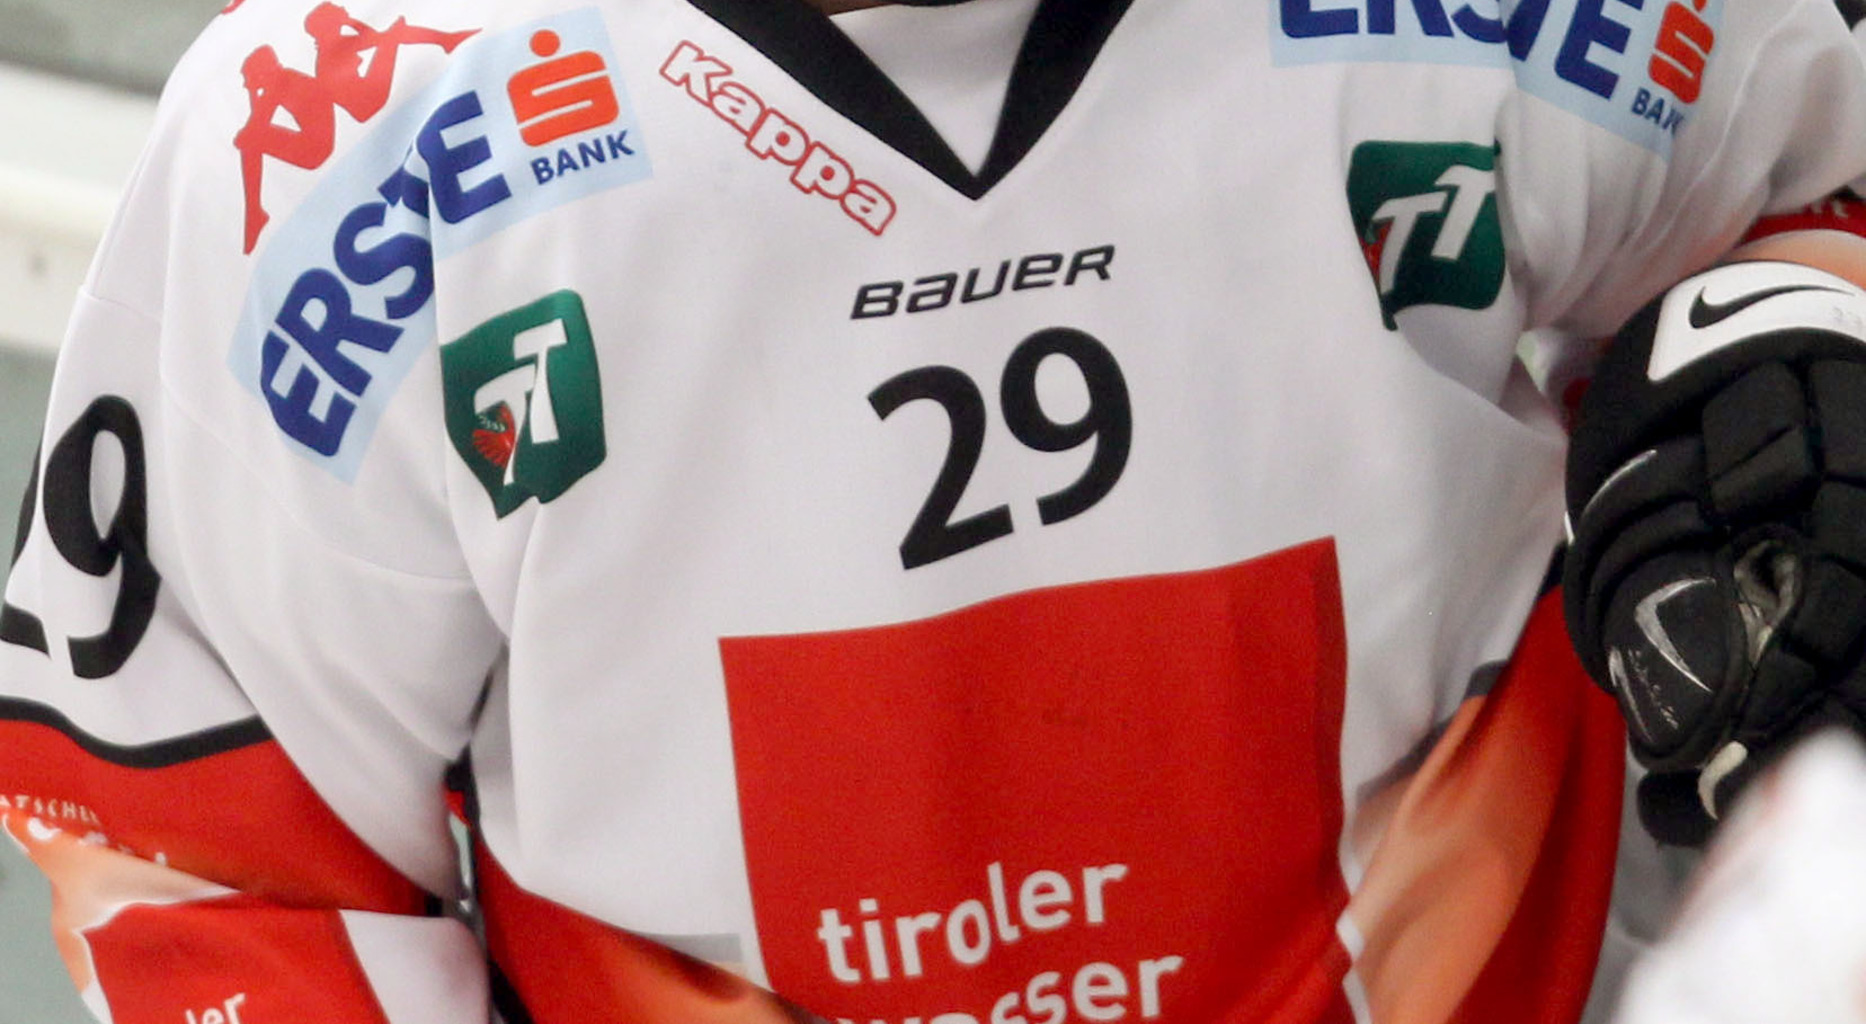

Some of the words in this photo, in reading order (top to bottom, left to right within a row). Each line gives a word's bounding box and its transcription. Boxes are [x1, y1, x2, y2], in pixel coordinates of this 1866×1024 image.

[530, 130, 635, 186] BANK
[659, 39, 898, 237] Kappa
[850, 244, 1116, 320] BAUER
[867, 326, 1133, 571] 29
[817, 861, 1129, 983] tiroler
[835, 954, 1184, 1024] sser
